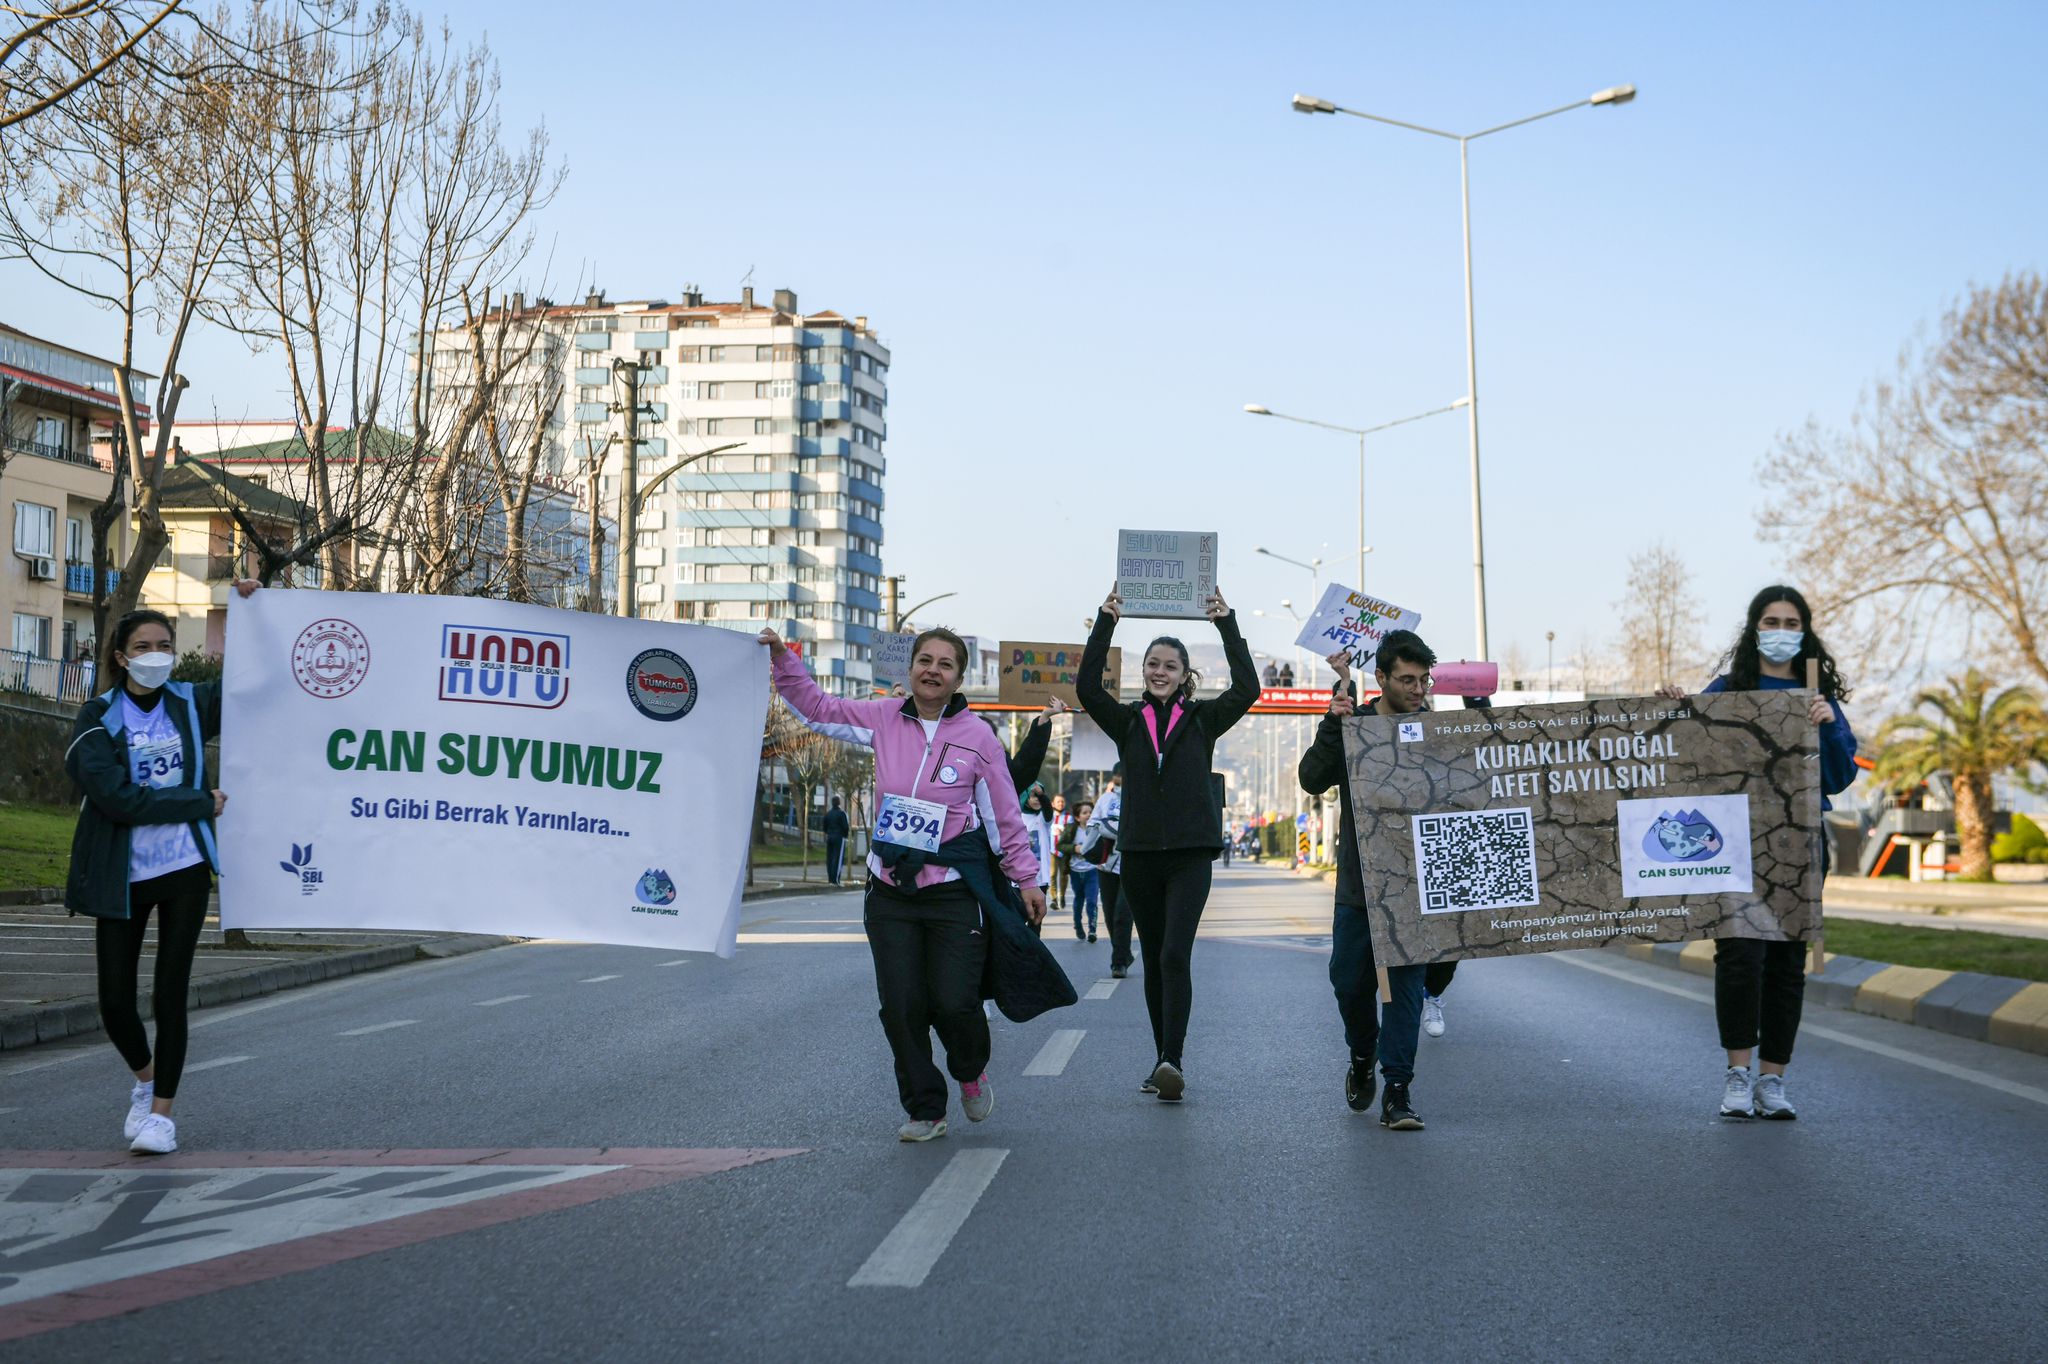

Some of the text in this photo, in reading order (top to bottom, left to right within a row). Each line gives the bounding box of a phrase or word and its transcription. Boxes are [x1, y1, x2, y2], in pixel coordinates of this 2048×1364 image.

[1126, 533, 1178, 553] SUYU
[1121, 558, 1184, 579] HAYATI
[1121, 581, 1193, 601] GELECEĞİ
[1345, 592, 1402, 620] KURAKLIĞI
[1356, 610, 1379, 626] YOK
[1322, 625, 1361, 646] AFET
[454, 660, 471, 668] HER
[480, 661, 505, 670] OKULUN
[535, 667, 560, 676] OLSUN
[1022, 669, 1079, 684] DAMLAY
[643, 677, 684, 691] TÜMKİAD
[1434, 708, 1691, 735] TRABZON SOSYAL BİLİMLER LİSESİ
[1474, 730, 1679, 770] KURAKLIK DOĞAL
[326, 728, 663, 794] CAN SUYUMUZ
[1491, 763, 1667, 798] AFET SAYILSIN!
[350, 796, 630, 837] Su Gibi Berrak Yarınlara...
[879, 809, 940, 838] 5394
[302, 871, 323, 883] SBL
[1638, 865, 1732, 879] CAN SUYUMUZ
[647, 907, 679, 916] SUYUMUZ
[1490, 905, 1690, 930] Kampanyamızı imzalayarak
[1521, 923, 1658, 944] destek olabilirsiniz!
